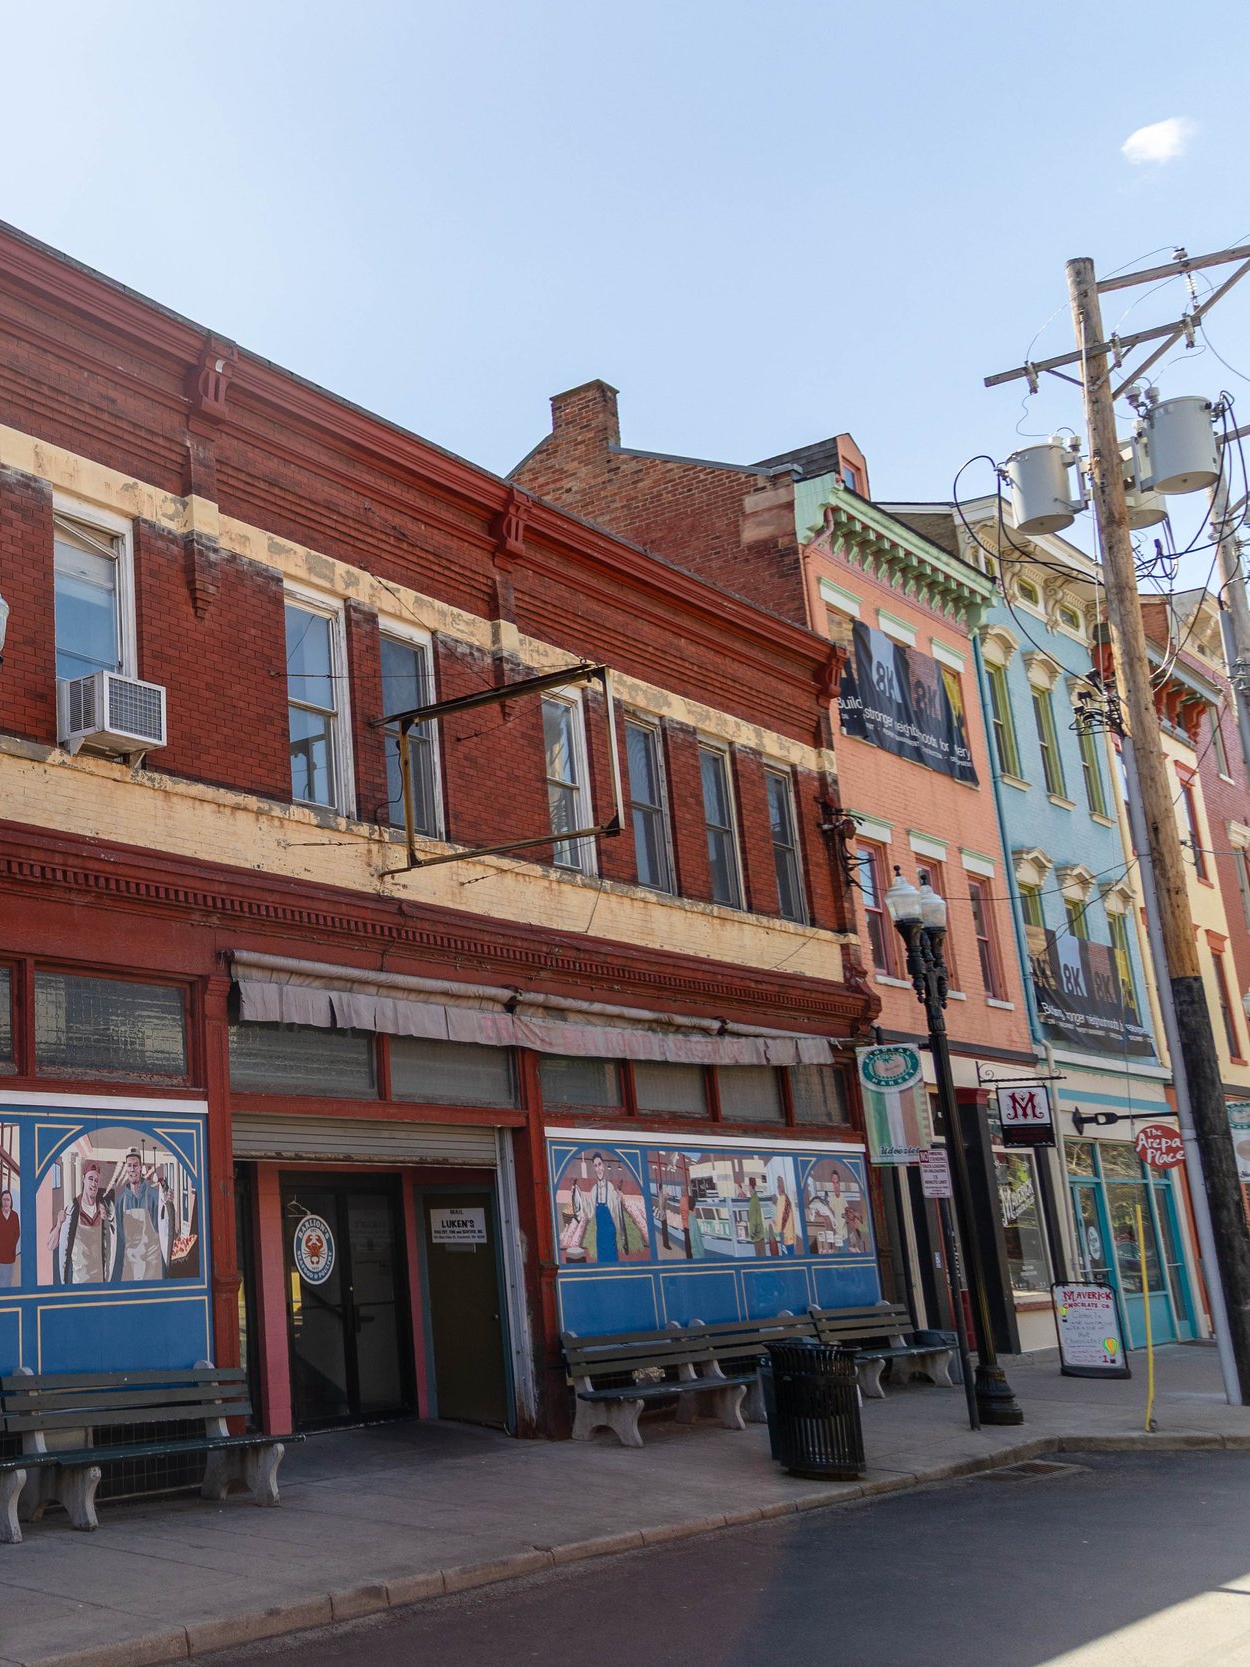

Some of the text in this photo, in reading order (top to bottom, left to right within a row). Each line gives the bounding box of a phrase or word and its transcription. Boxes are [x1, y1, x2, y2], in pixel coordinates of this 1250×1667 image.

[865, 1047, 911, 1063] FINDLAY
[872, 1069, 914, 1086] MARKET
[1007, 1091, 1045, 1120] M
[1145, 1128, 1162, 1136] The
[1136, 1133, 1183, 1152] Arepa
[1147, 1149, 1185, 1165] Place
[441, 1219, 475, 1228] LUKEN'S
[1063, 1291, 1112, 1301] MAVERICK
